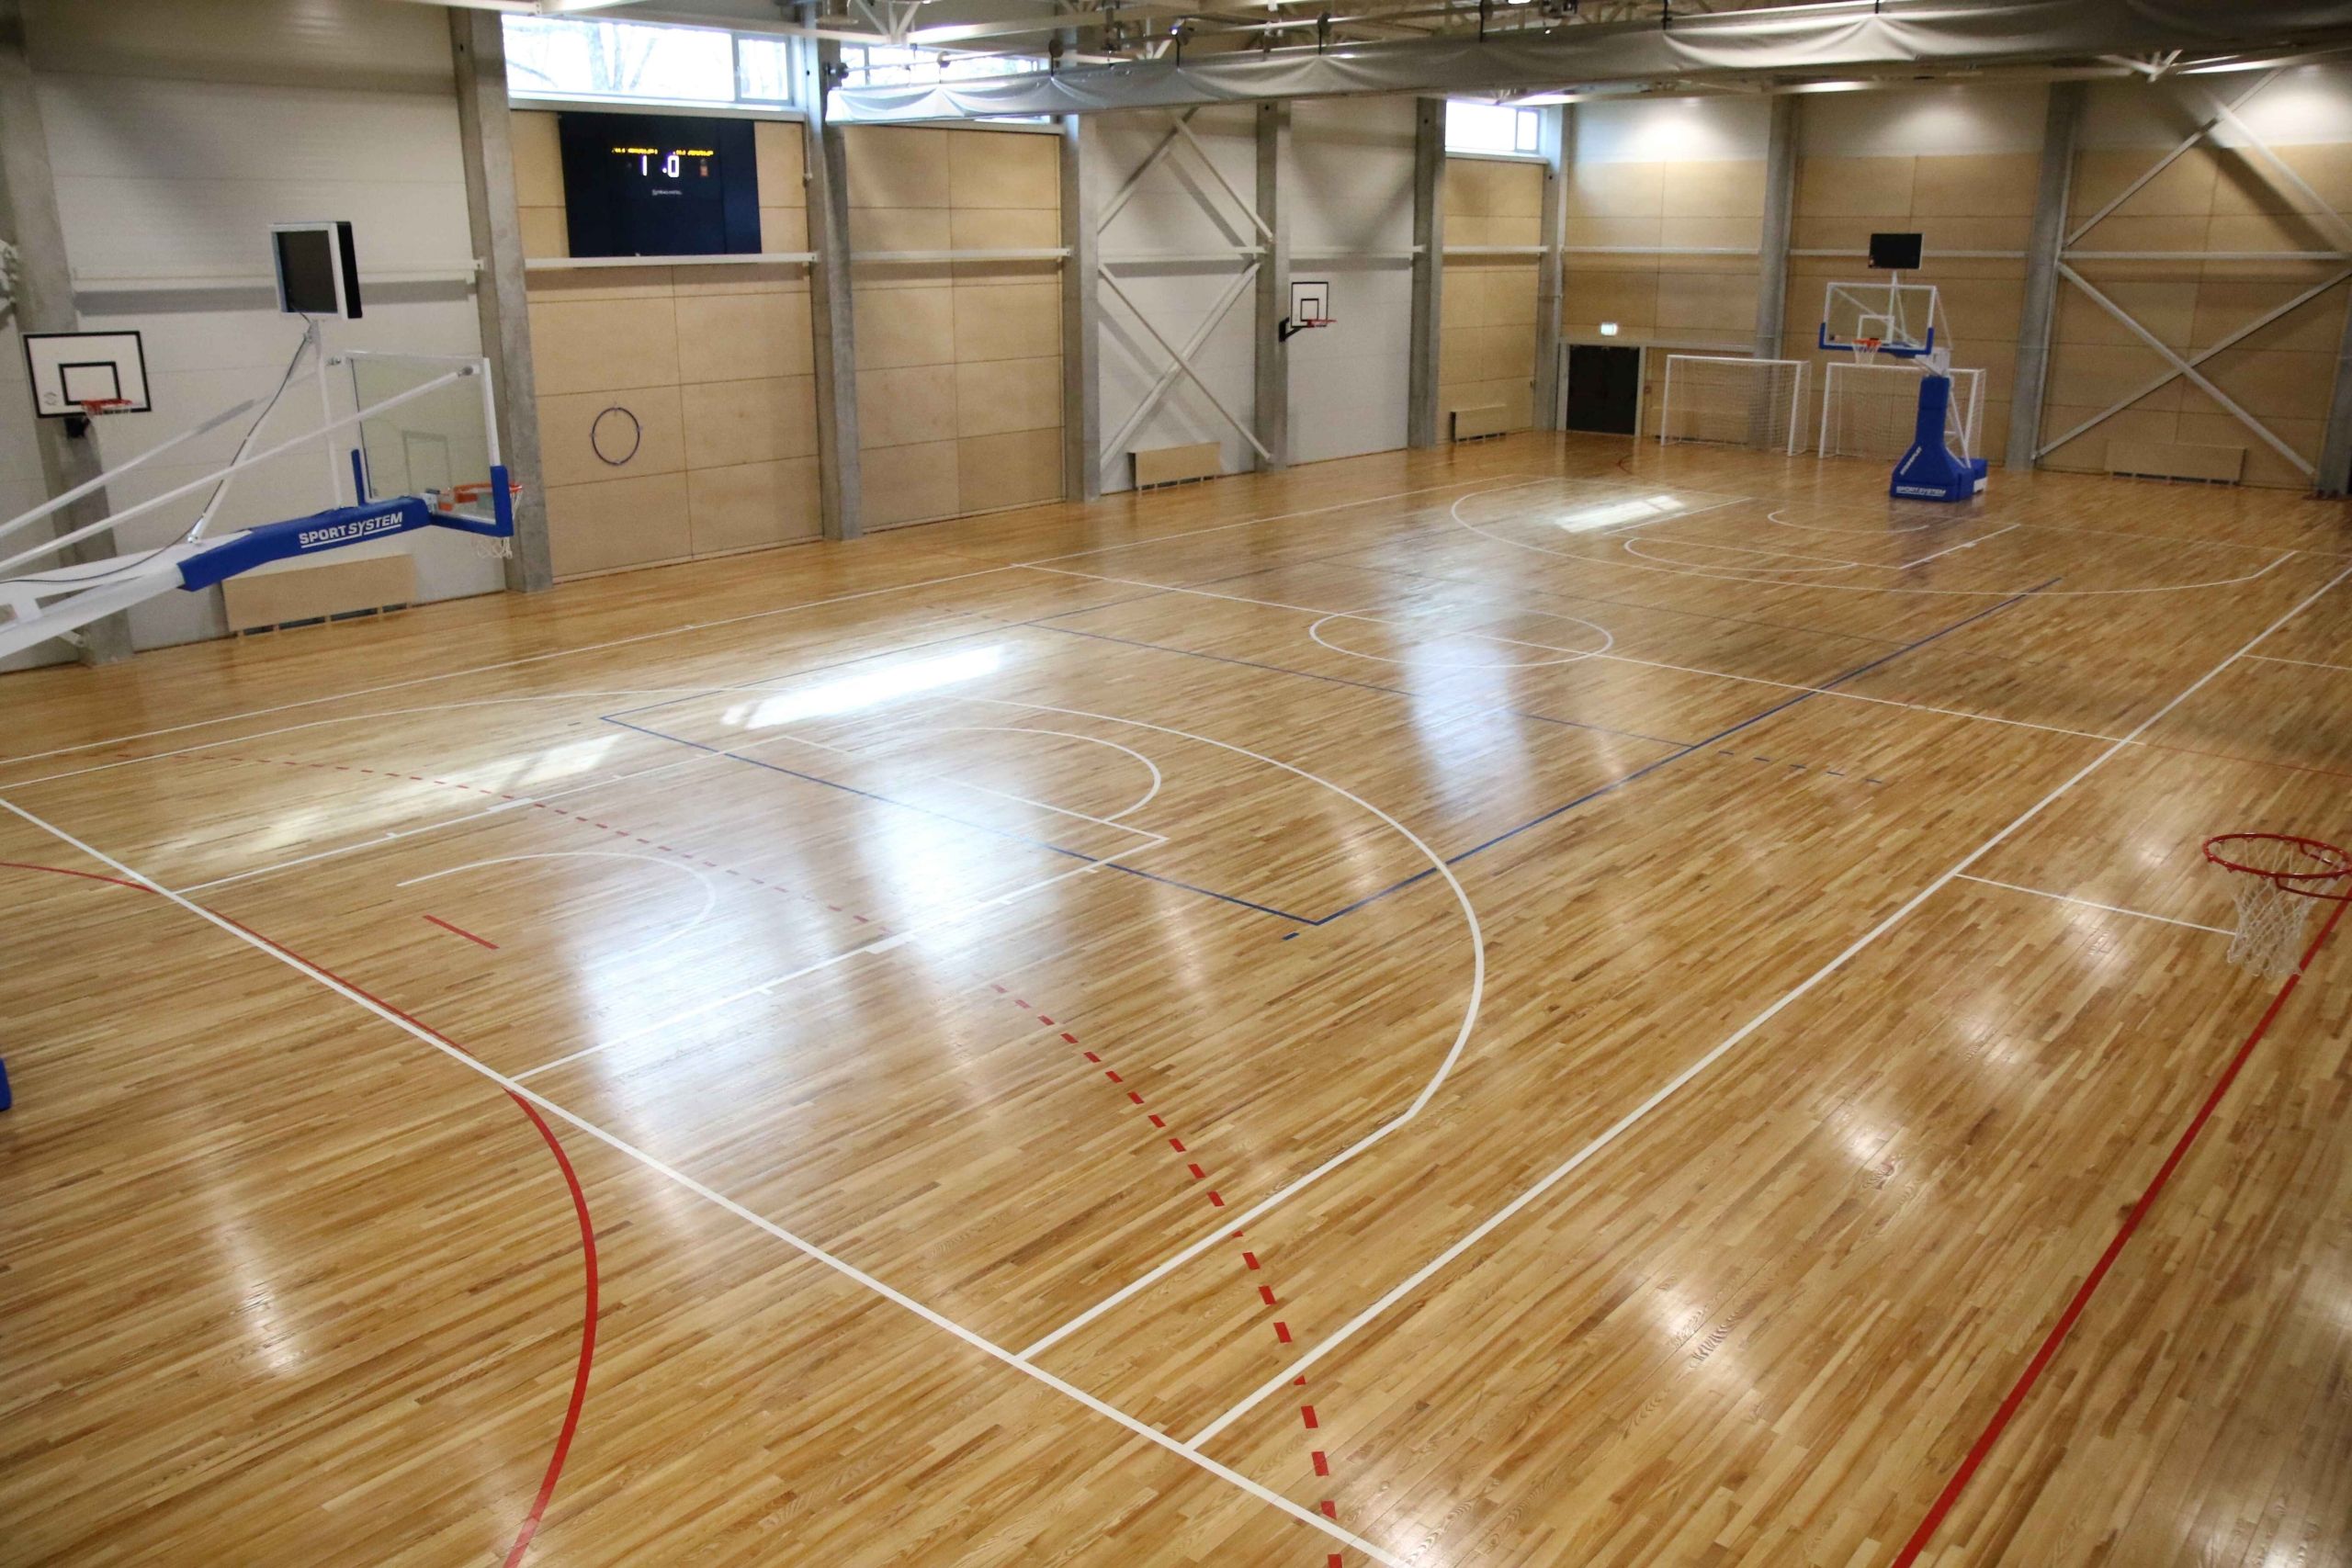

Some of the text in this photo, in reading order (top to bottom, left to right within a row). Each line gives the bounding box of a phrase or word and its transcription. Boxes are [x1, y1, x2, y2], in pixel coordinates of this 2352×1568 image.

[1918, 487, 1947, 497] SYSTEM
[299, 512, 402, 545] SPORT SYSTEM
